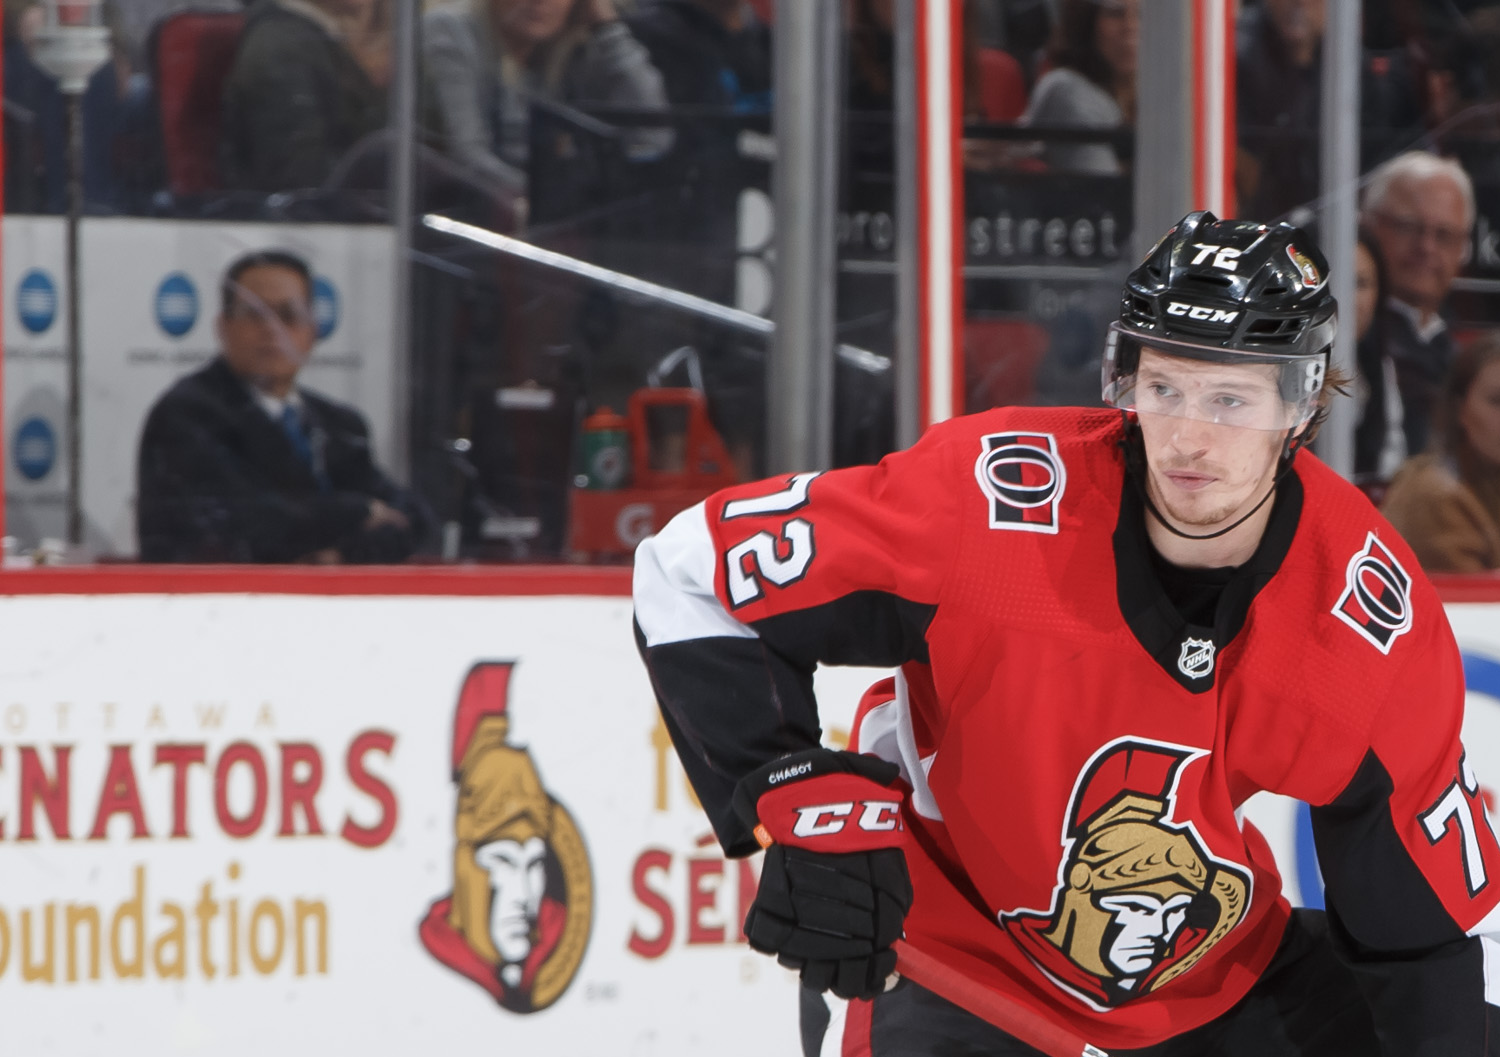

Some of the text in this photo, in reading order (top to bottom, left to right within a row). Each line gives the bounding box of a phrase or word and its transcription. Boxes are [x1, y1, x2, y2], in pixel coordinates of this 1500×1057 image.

[1191, 243, 1242, 271] 72
[1166, 301, 1240, 325] CCM
[1185, 650, 1210, 669] NHL
[5, 702, 275, 734] OTTAWA
[768, 761, 812, 785] CHABOT
[0, 731, 398, 849] NATORS
[791, 799, 904, 839] CC
